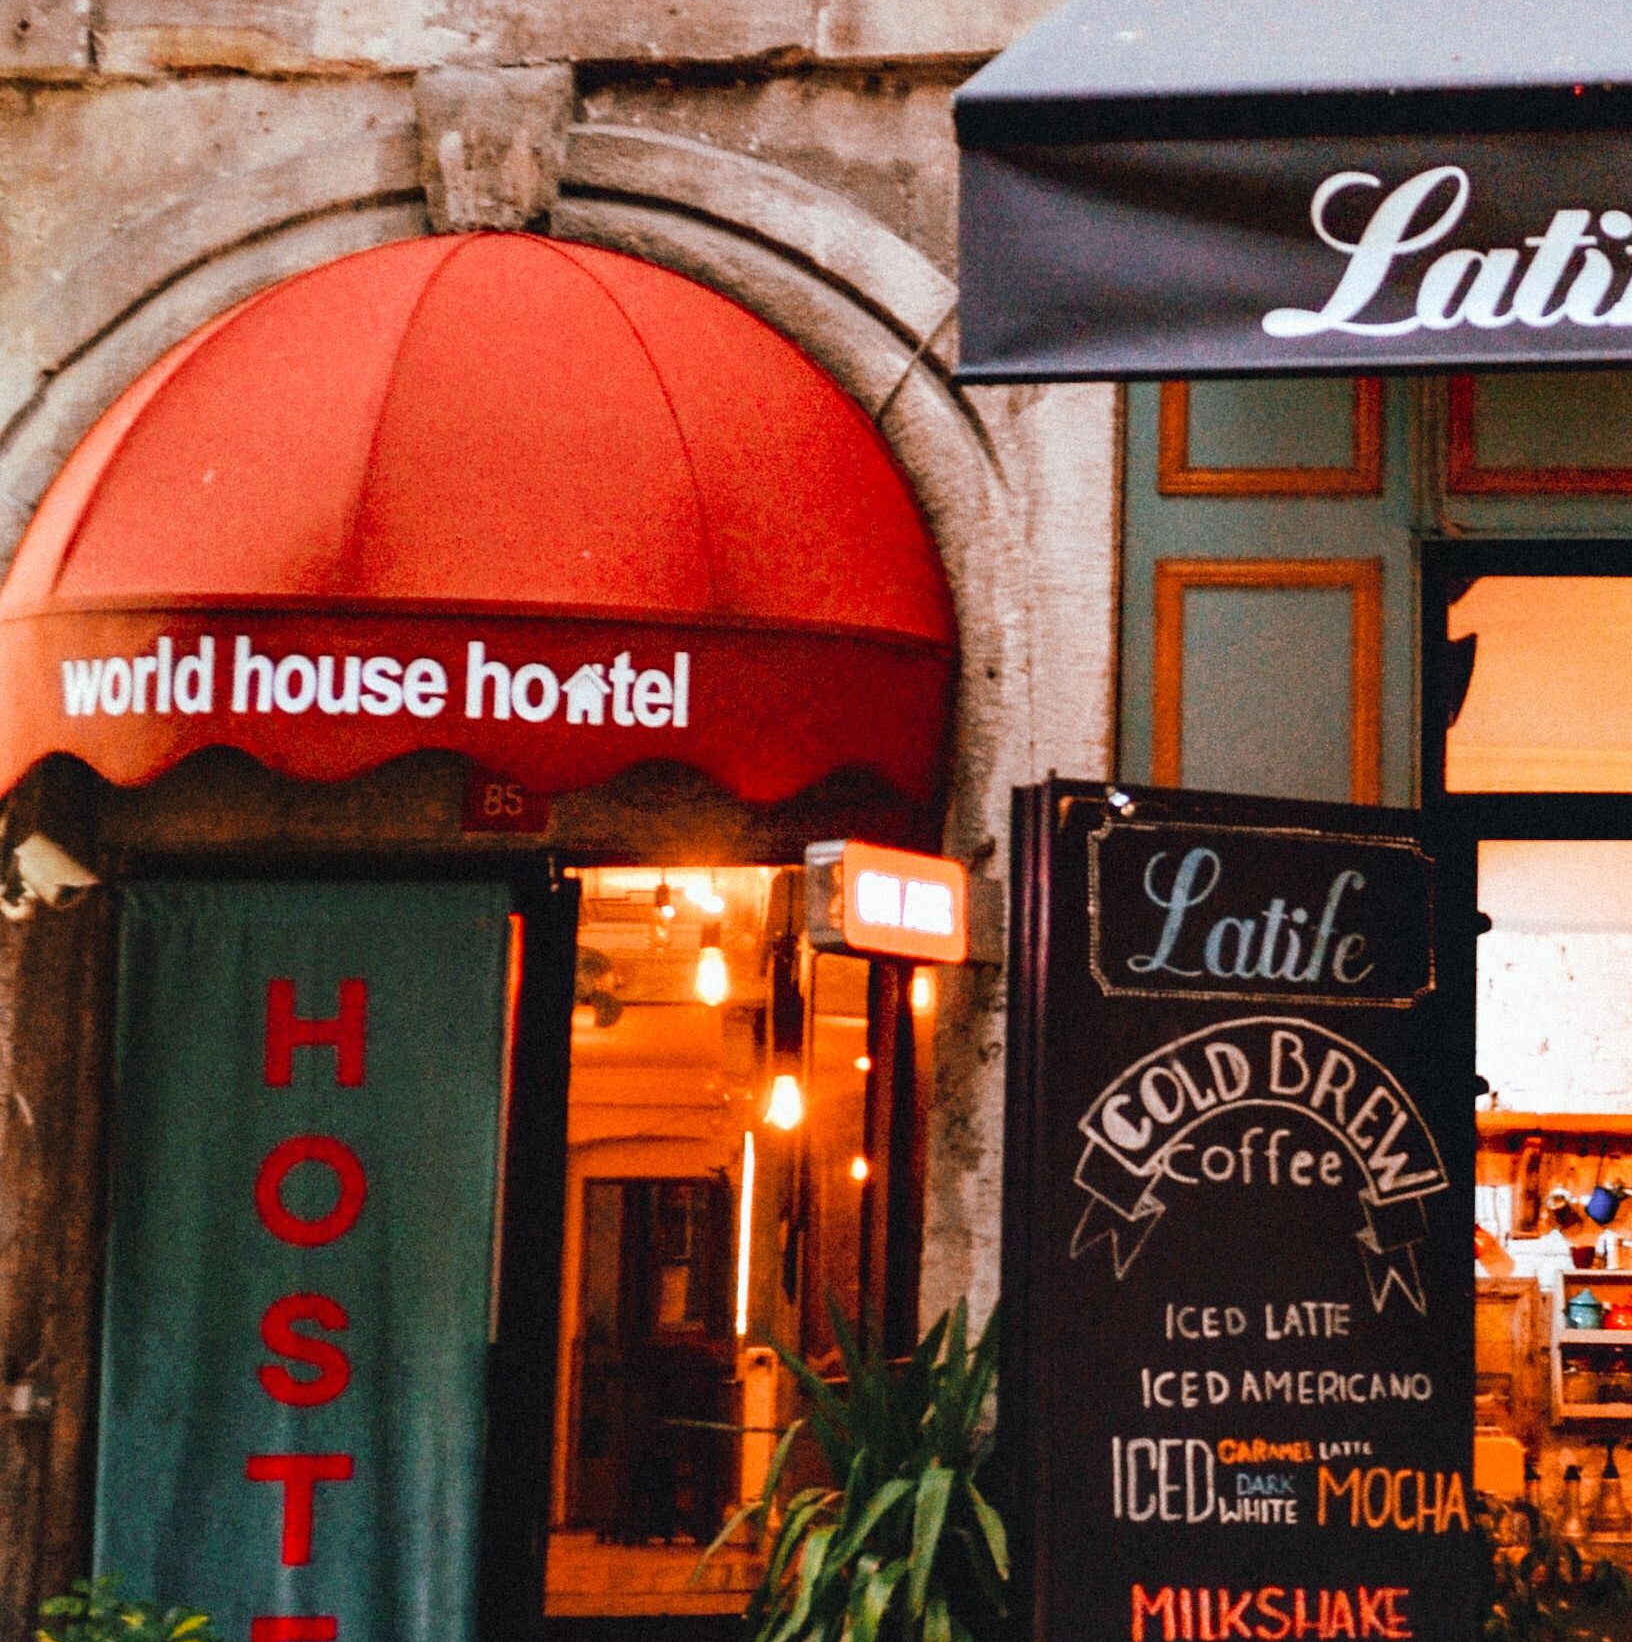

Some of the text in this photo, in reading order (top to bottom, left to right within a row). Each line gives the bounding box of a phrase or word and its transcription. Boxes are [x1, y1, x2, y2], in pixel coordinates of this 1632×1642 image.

[61, 636, 216, 717] world
[231, 635, 448, 718] house
[484, 783, 523, 816] 85
[1126, 846, 1376, 985] Latife
[1101, 1029, 1440, 1193] COLD BREW
[1165, 1301, 1351, 1341] ICED LATTE
[1141, 1367, 1433, 1408] ICED AMERICANO
[1217, 1438, 1373, 1465] CARAMEL LATTE
[1111, 1436, 1216, 1525] ICED
[1236, 1472, 1296, 1496] DARK
[1316, 1465, 1470, 1534] MOCHA
[1217, 1496, 1299, 1526] WHITE
